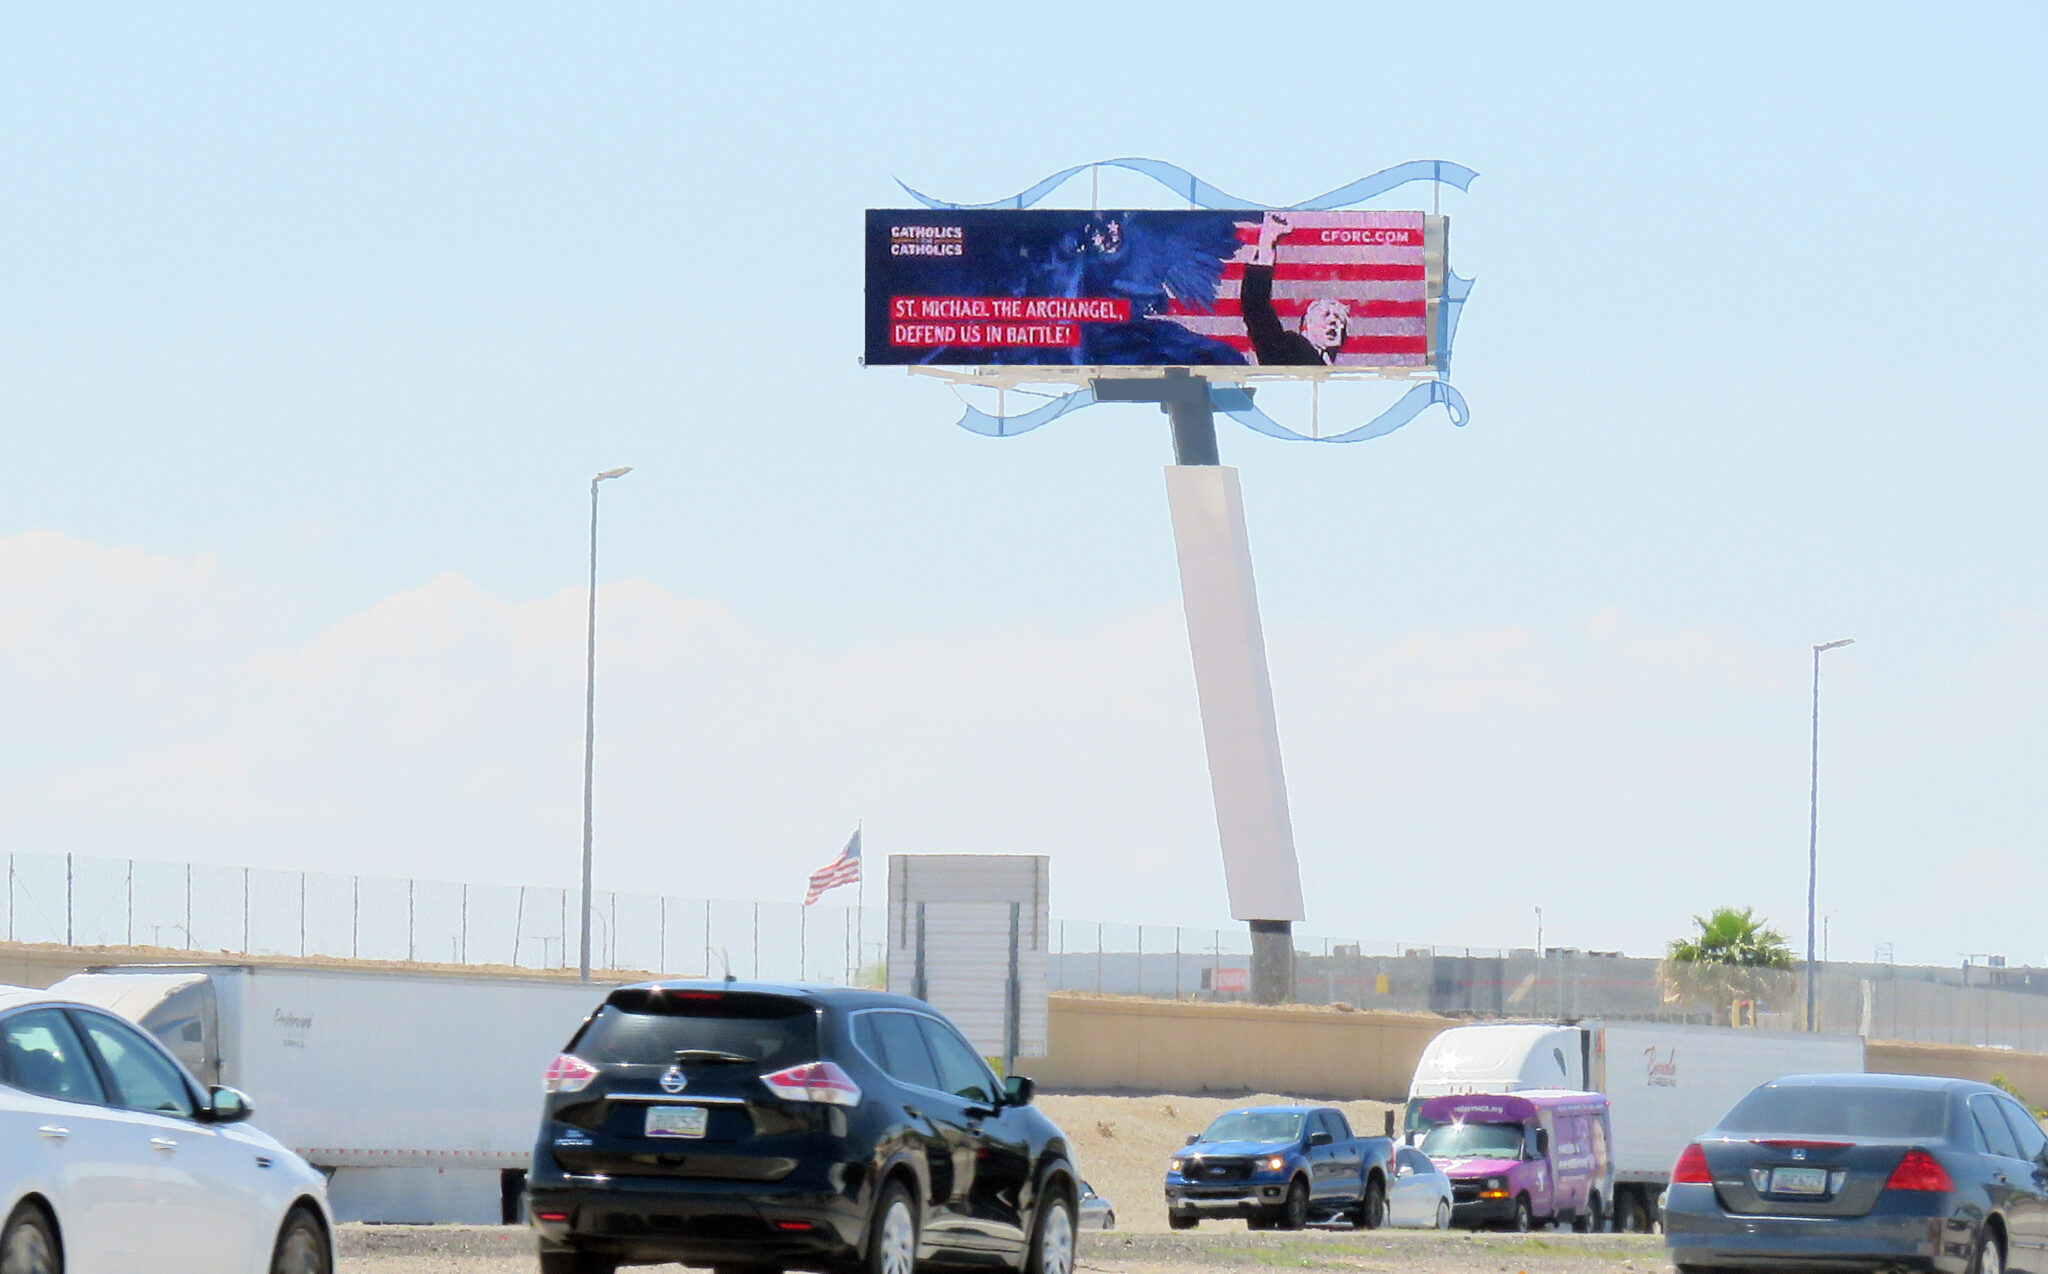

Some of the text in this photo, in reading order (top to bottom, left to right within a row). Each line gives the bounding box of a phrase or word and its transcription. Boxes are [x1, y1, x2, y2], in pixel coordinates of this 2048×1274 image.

[891, 226, 962, 238] CATHOLICS
[1321, 230, 1409, 243] CFORC.COM
[891, 244, 963, 256] CATHOLICS
[896, 300, 1123, 322] ST. MICHAEL THE ARCHANGEL,
[895, 325, 1070, 344] DEFEND US IN BATTLE!
